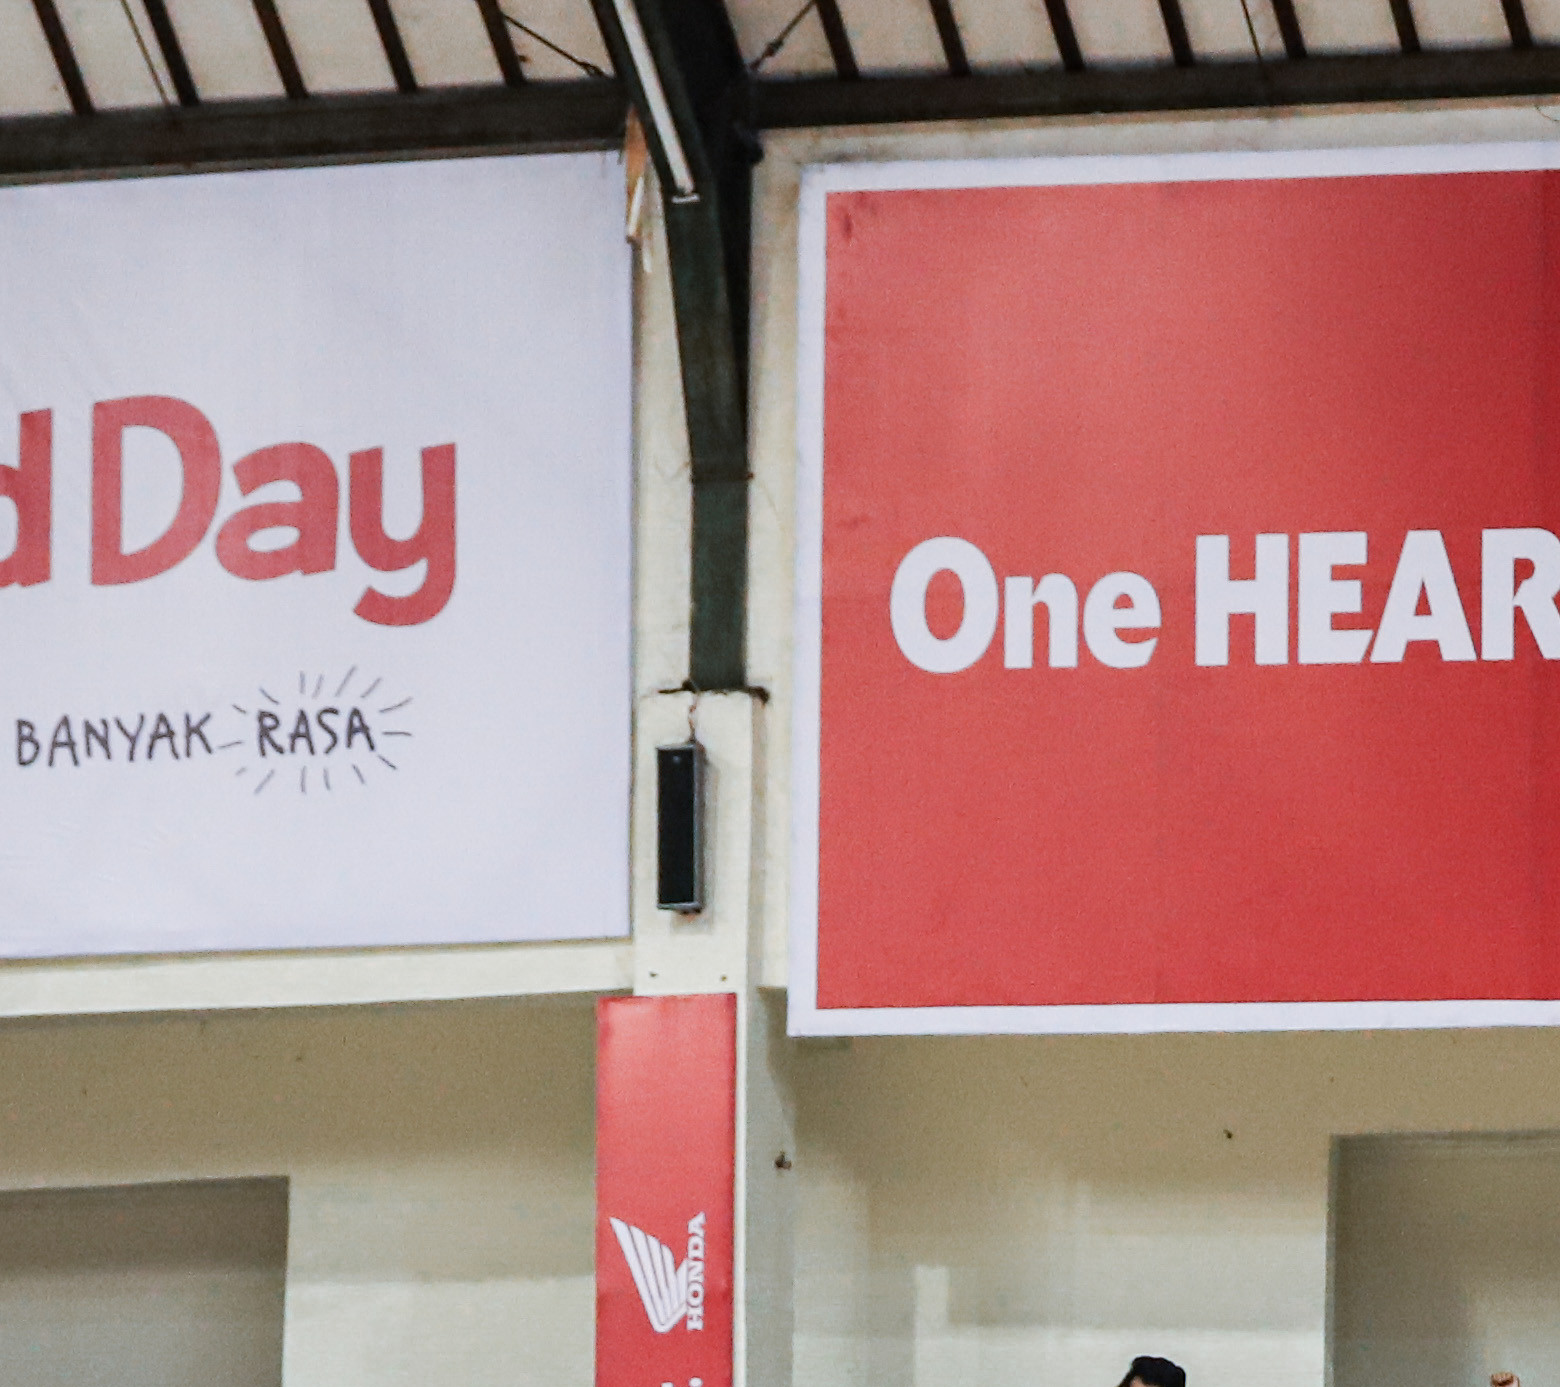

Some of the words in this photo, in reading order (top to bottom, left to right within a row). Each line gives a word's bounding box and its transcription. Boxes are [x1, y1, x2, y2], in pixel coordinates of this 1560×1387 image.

[91, 395, 456, 626] Day
[890, 536, 1161, 674] One
[16, 712, 213, 768] BANYAK
[257, 705, 377, 760] RASA
[686, 1213, 705, 1331] HONDA
